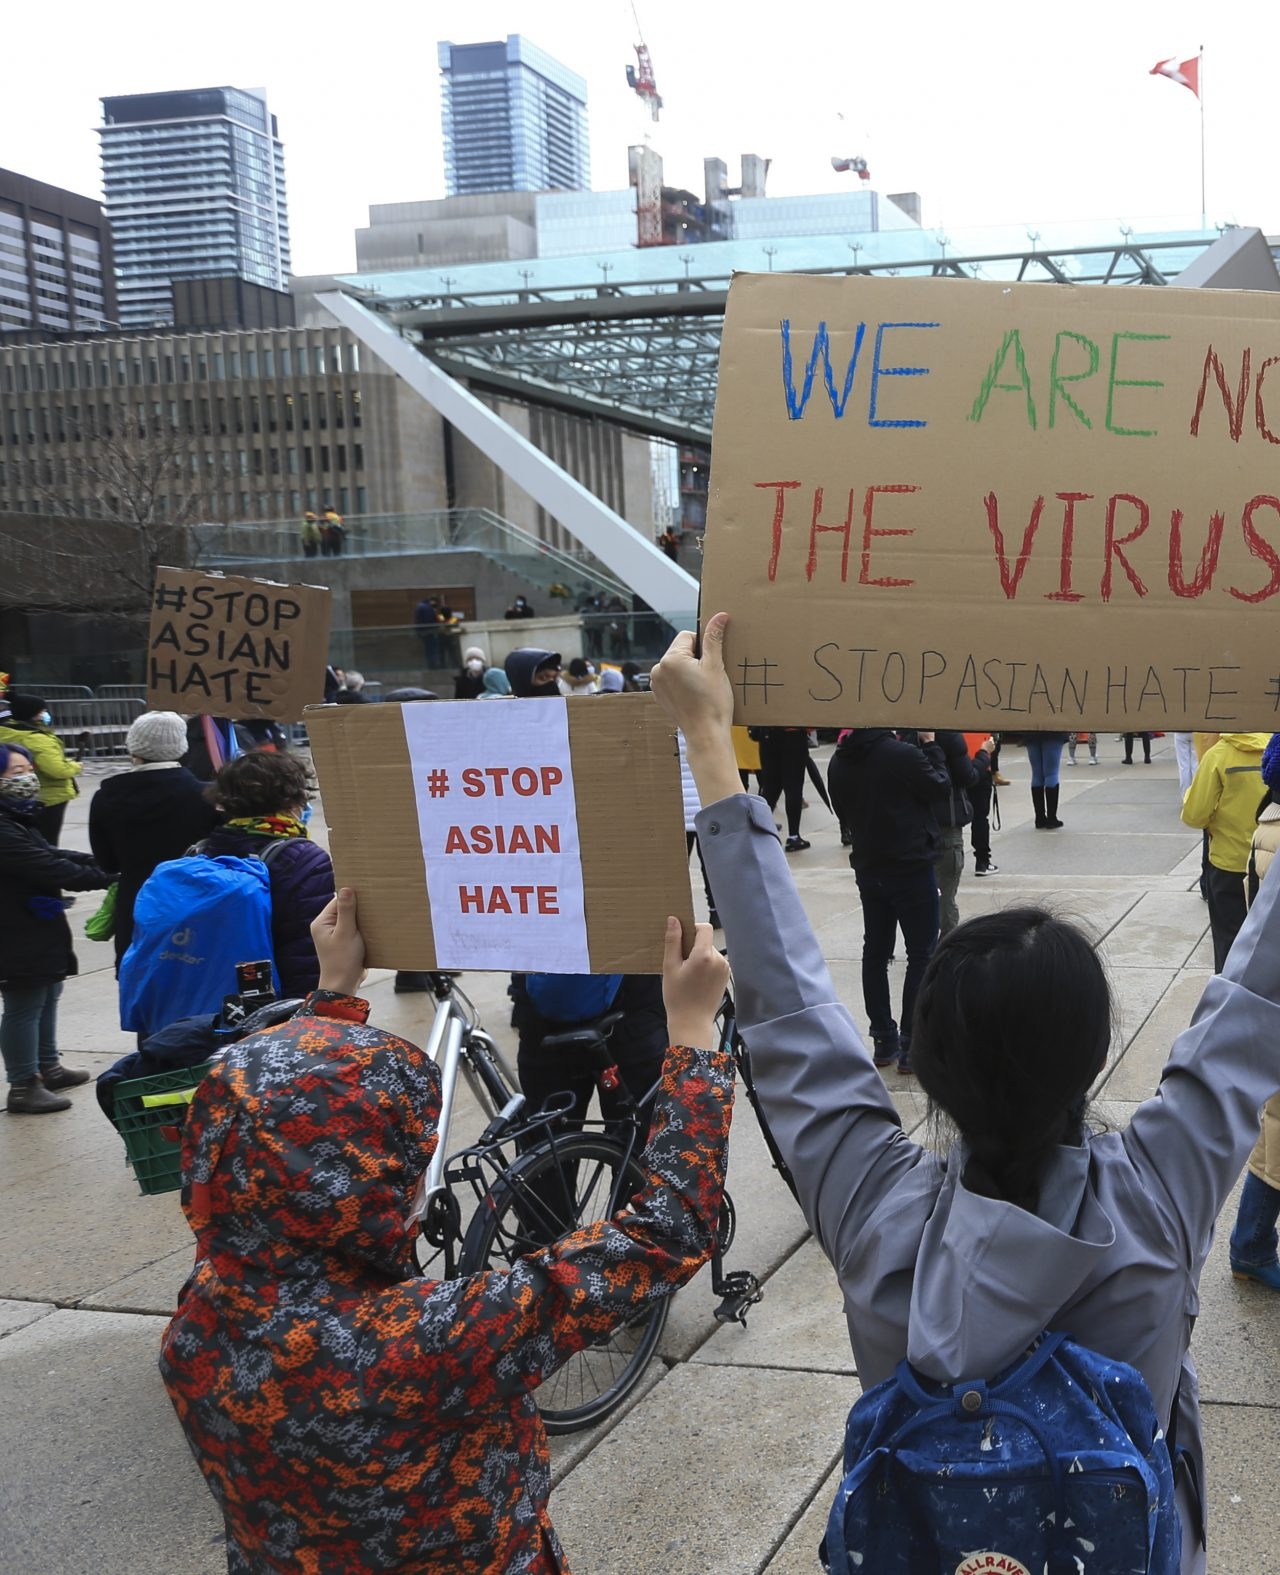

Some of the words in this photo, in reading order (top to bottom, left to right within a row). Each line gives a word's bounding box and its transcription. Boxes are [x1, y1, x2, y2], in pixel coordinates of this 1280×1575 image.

[780, 318, 941, 428] WE
[966, 329, 1171, 436] ARE
[753, 480, 922, 587] THE
[155, 583, 301, 631] #STOP
[152, 621, 290, 670] ASIAN
[151, 657, 272, 705] HATE
[735, 657, 784, 706] #
[427, 769, 450, 798] #
[461, 767, 563, 797] STOP
[445, 825, 561, 854] ASIAN
[459, 886, 560, 914] HATE
